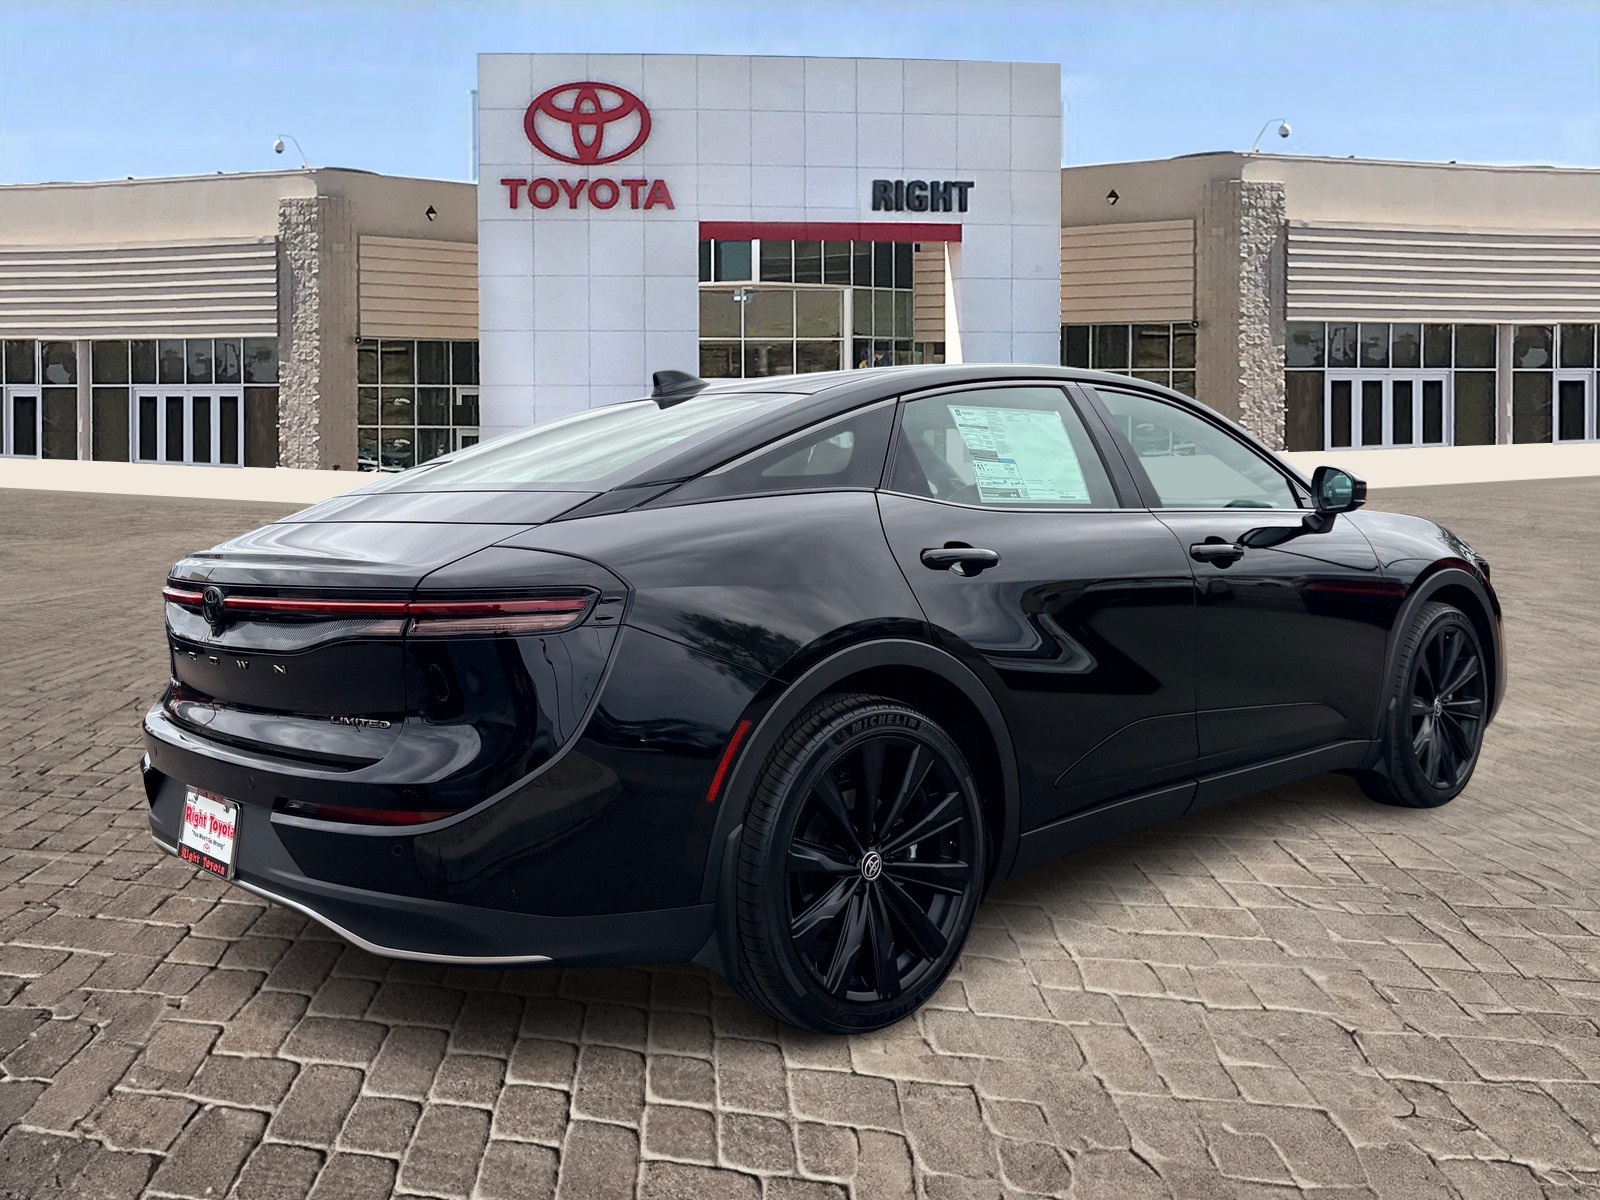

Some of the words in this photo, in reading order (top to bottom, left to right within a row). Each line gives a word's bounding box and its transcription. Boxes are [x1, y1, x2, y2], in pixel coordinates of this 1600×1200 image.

[500, 178, 675, 210] TOYOTA
[871, 179, 975, 213] RIGHT
[330, 715, 392, 730] LIMITED
[851, 714, 918, 733] MICHELIN
[185, 805, 207, 829] Right
[209, 813, 235, 840] Toyota
[181, 847, 200, 862] Right
[202, 857, 225, 875] Toyota
